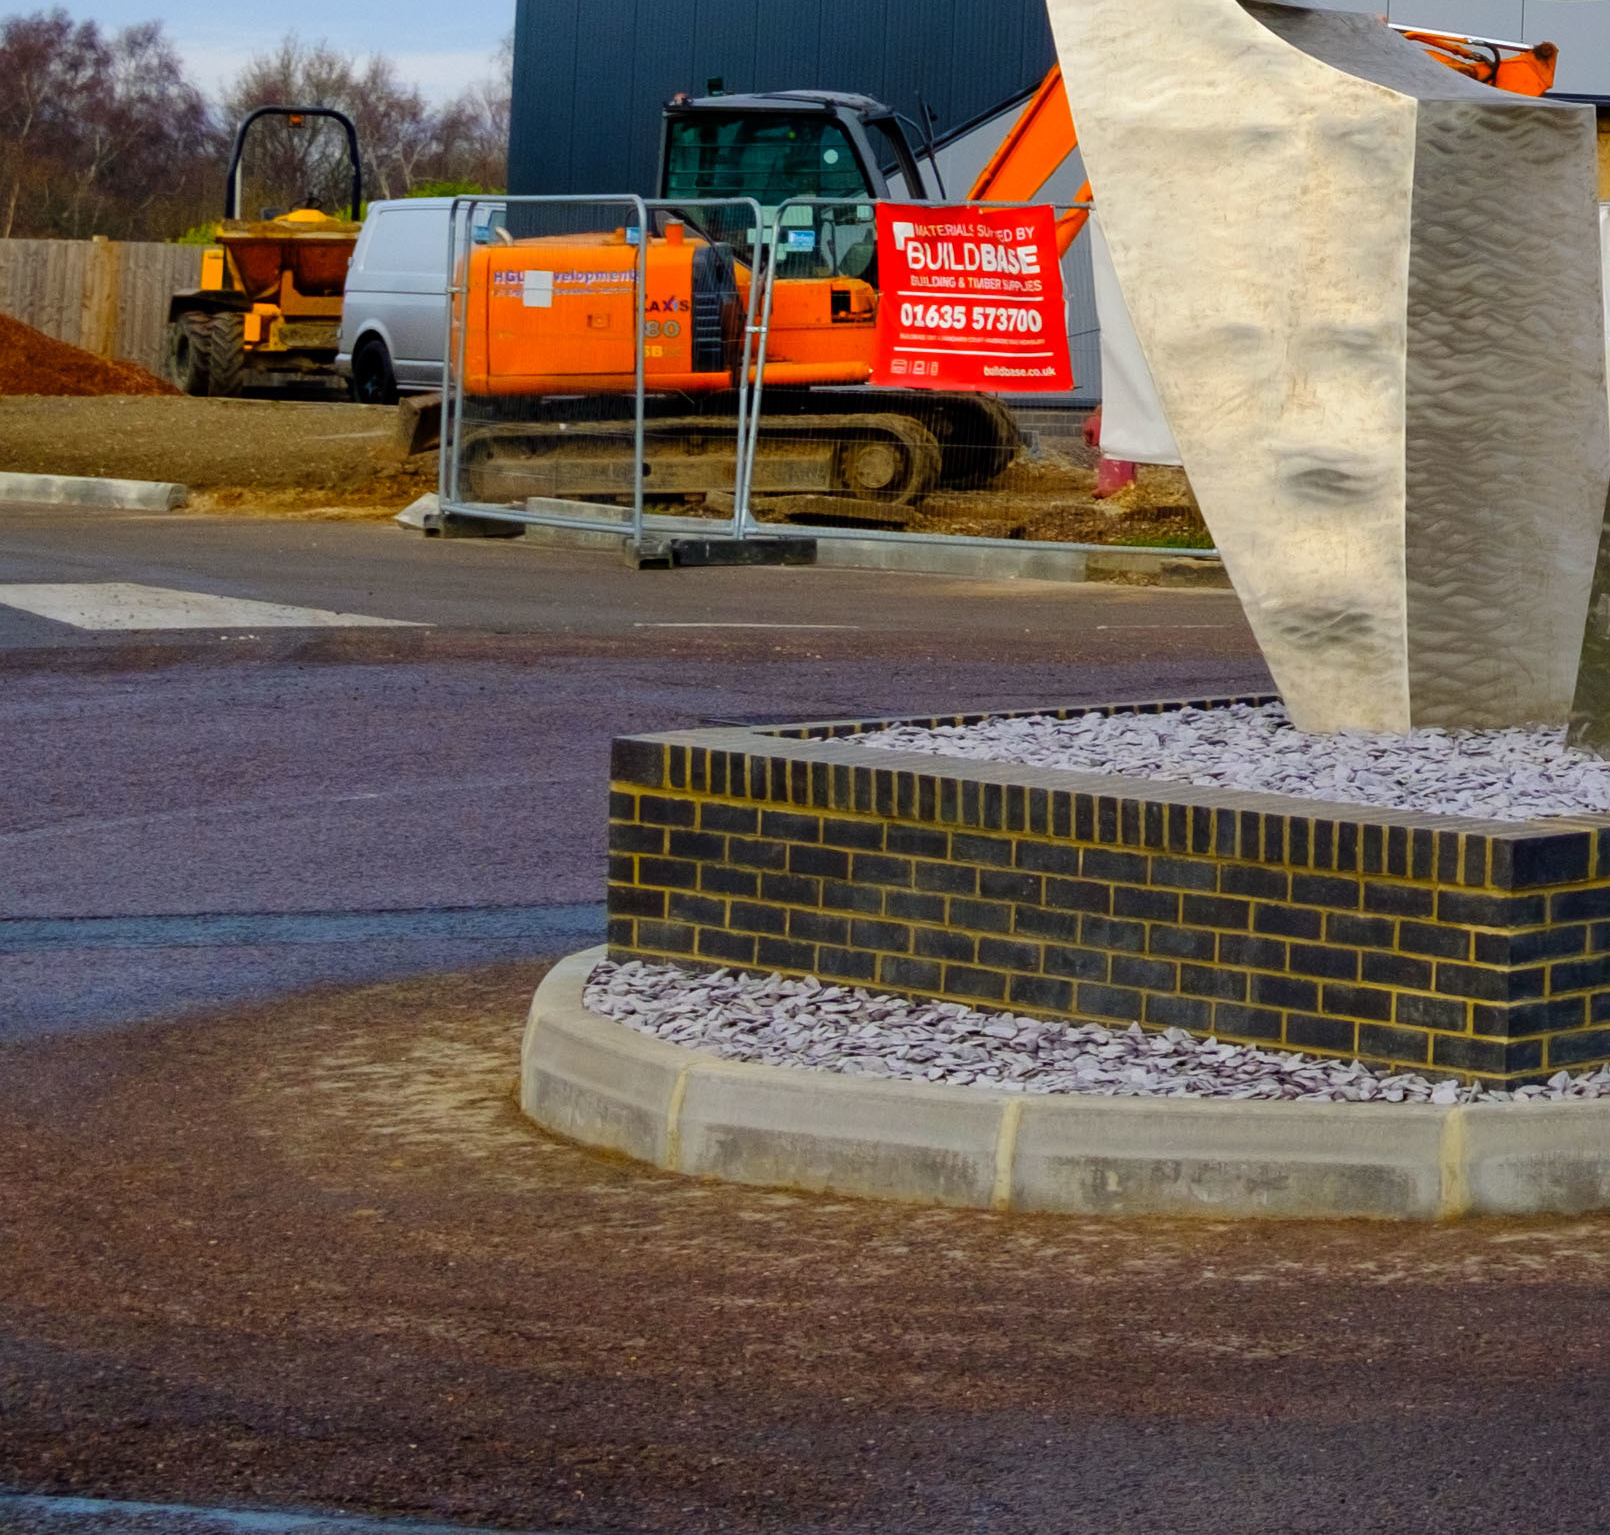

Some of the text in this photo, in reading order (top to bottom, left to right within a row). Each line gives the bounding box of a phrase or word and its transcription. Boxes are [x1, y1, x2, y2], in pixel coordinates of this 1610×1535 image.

[1016, 226, 1035, 241] BY
[906, 241, 1041, 275] BUILDBASE
[910, 275, 1043, 292] BUILDING & TIMBER SUPPLIES
[901, 303, 1042, 332] 01635 573700
[984, 366, 1057, 377] buildbase.co.uk
